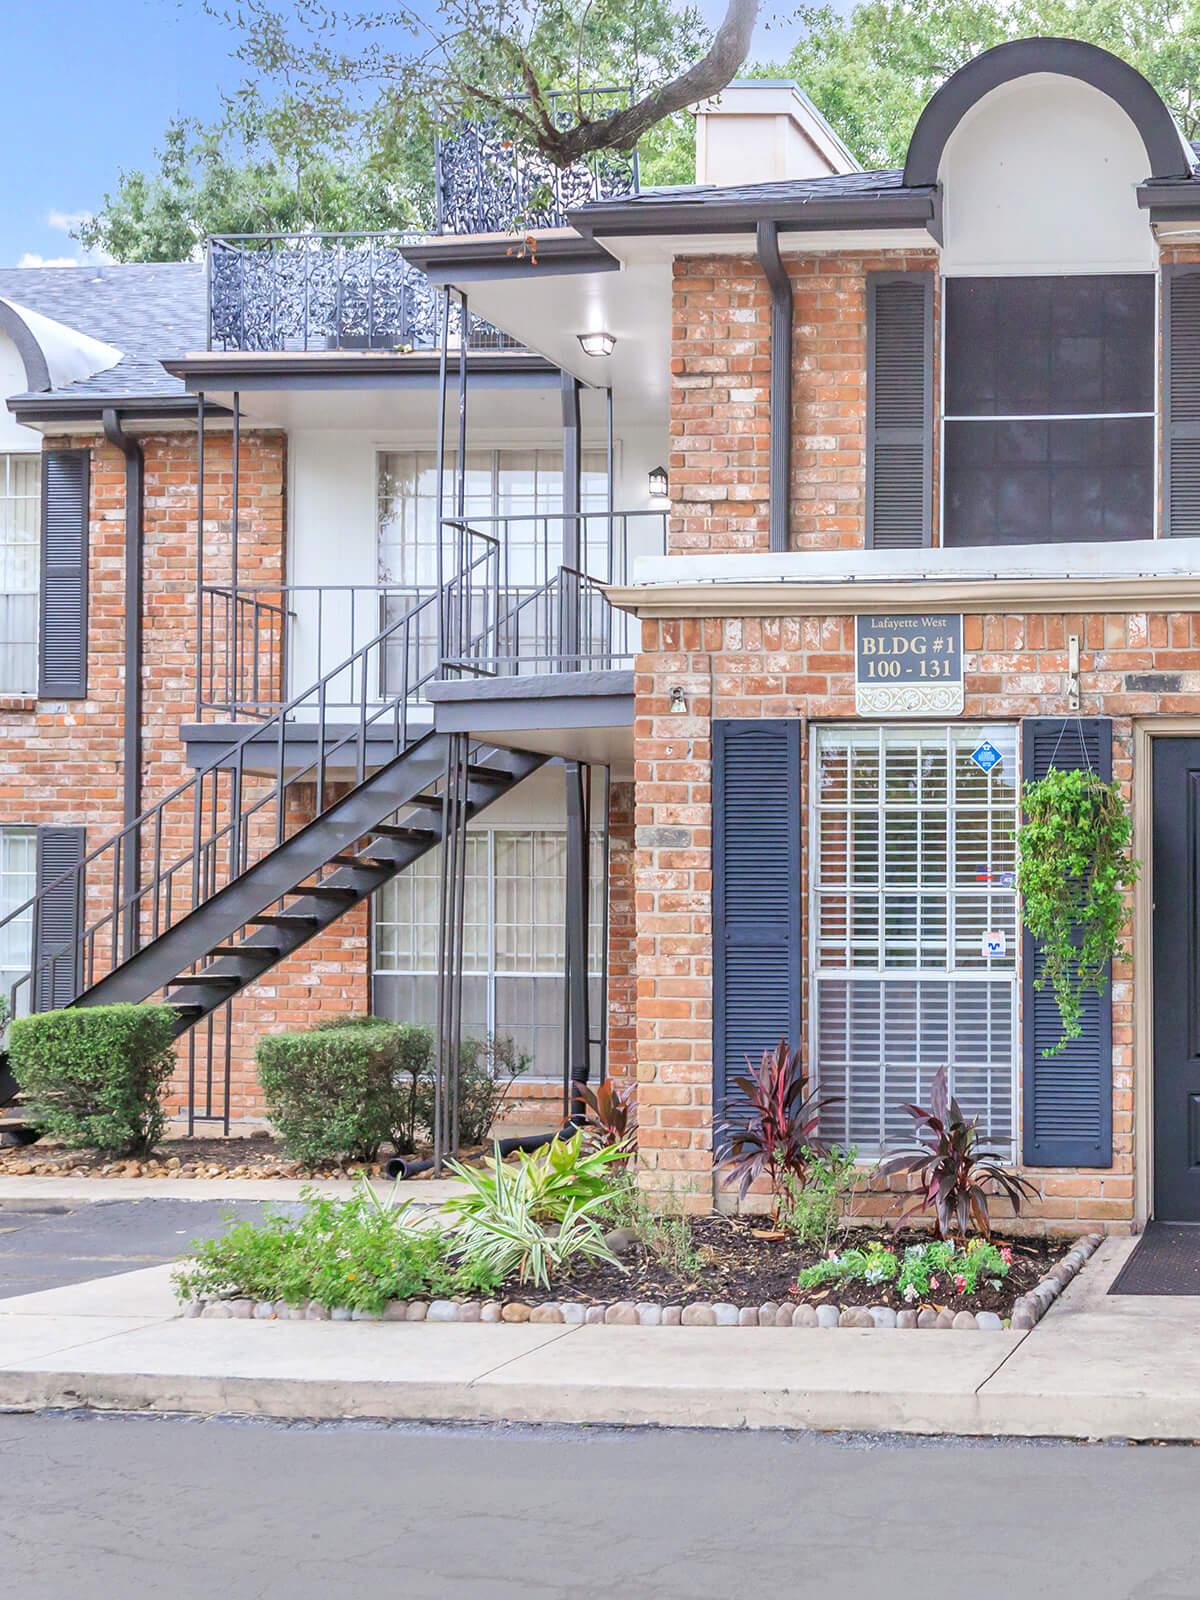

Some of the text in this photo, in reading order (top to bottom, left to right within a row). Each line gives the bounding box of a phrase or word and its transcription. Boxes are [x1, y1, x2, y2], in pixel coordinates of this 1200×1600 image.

[871, 617, 947, 630] Lafayette West
[862, 636, 955, 655] BLDG #1
[868, 660, 901, 678] 100
[920, 660, 951, 678] 131
